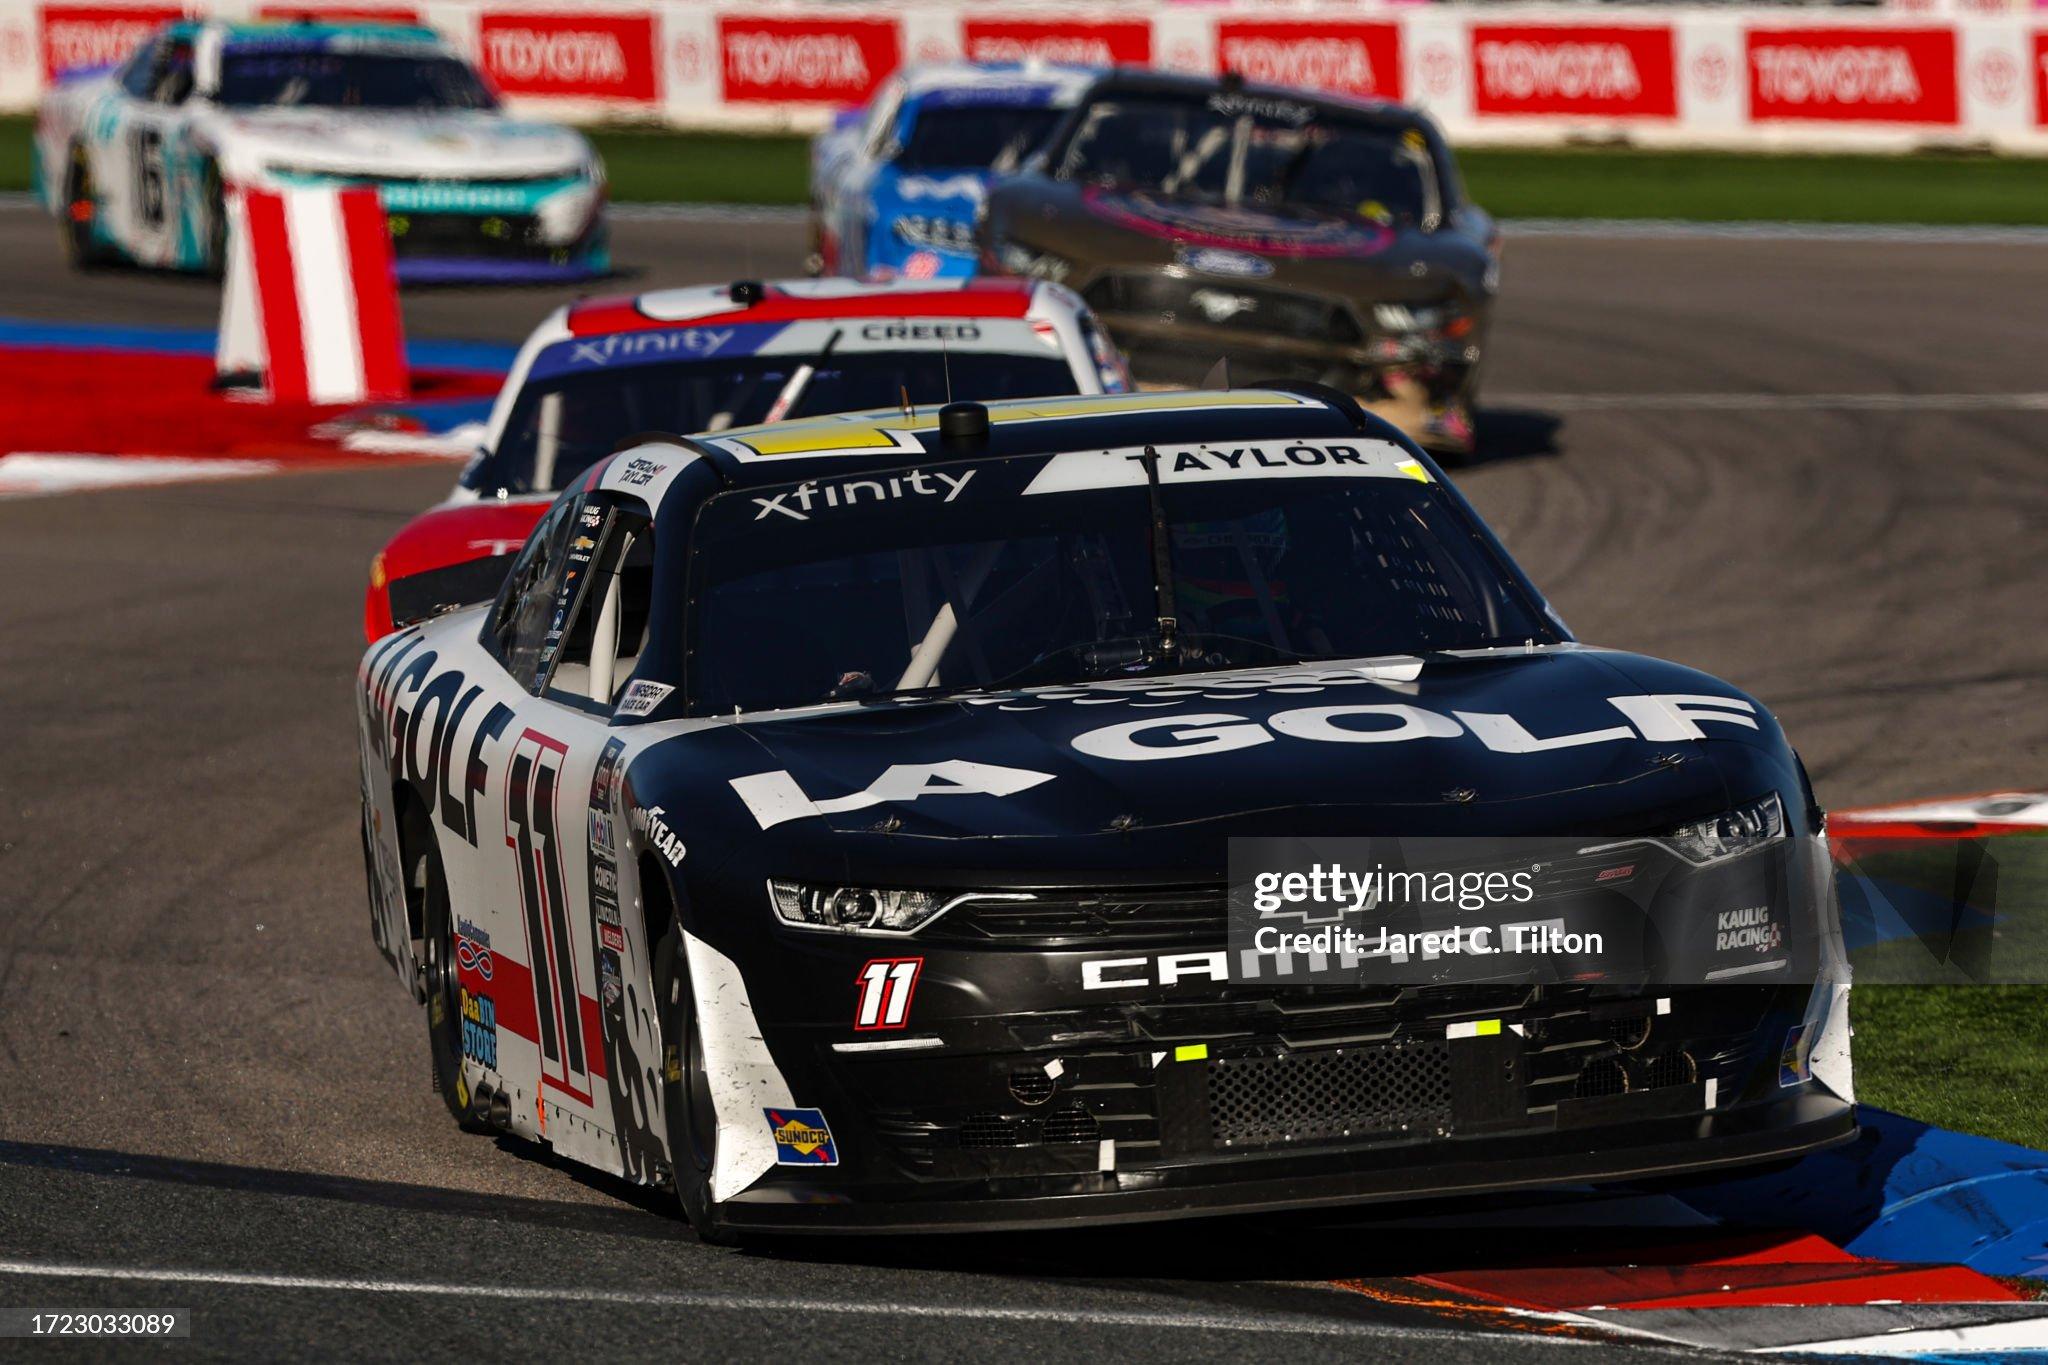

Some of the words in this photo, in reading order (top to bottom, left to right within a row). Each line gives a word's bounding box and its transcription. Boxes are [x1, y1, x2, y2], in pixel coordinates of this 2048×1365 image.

[485, 26, 626, 84] TOYOTA
[725, 31, 870, 88] TOYOTA
[1478, 41, 1641, 98] TOYOTA
[1751, 46, 1922, 103] TOYOTA
[569, 327, 735, 366] xfinity
[862, 321, 981, 342] CREED
[618, 469, 654, 486] TAYLOR
[1126, 445, 1368, 474] TAYLOR
[753, 468, 978, 521] xfinity
[635, 700, 651, 711] CAR
[728, 759, 1057, 830] LA
[1070, 694, 1760, 761] GOLF
[1716, 926, 1771, 951] RACING
[1718, 906, 1769, 931] KAULIG
[855, 957, 924, 1031] 11
[463, 1022, 497, 1071] STORE
[777, 1129, 826, 1144] SUNOCO
